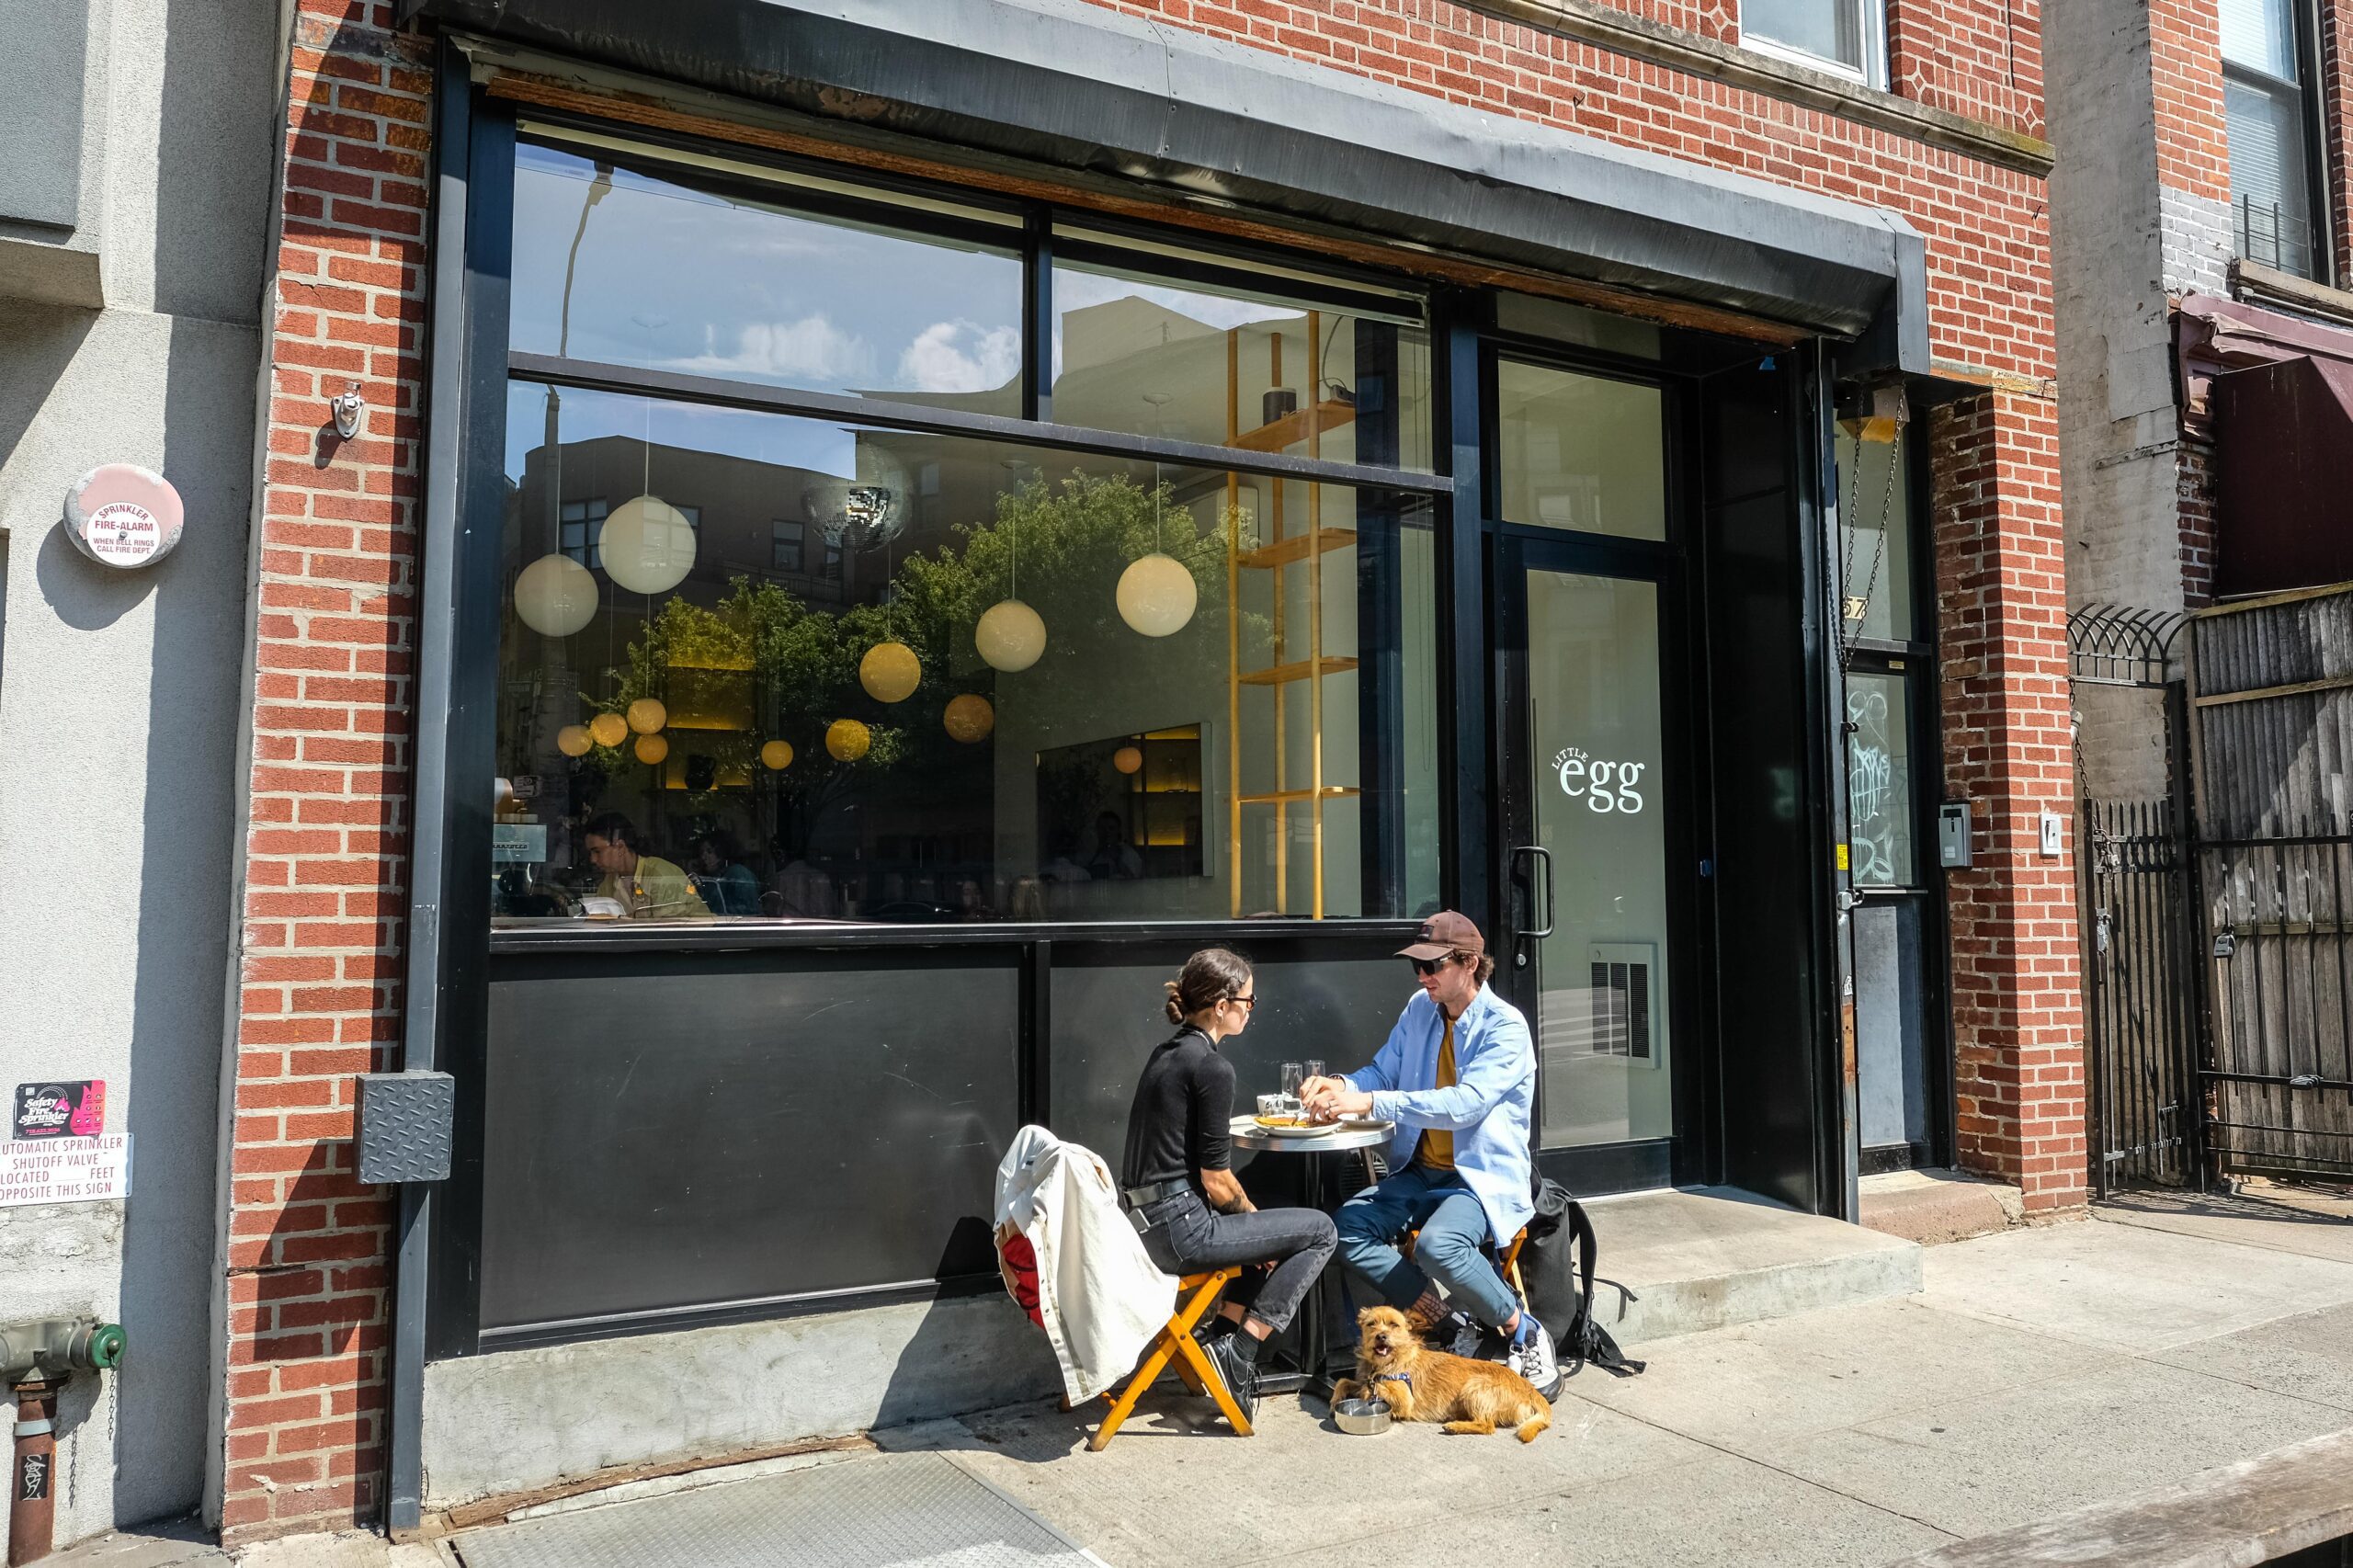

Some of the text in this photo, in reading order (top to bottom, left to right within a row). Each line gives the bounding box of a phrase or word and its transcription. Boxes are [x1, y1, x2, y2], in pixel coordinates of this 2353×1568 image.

[98, 504, 149, 521] SPRINKLER
[95, 520, 153, 531] FIRE-ALARM
[116, 538, 131, 546] BELL
[133, 539, 154, 547] RINGS
[1551, 747, 1589, 770] LITTLE
[1559, 759, 1645, 814] egg
[24, 1096, 58, 1108] Safety
[18, 1110, 70, 1126] Sprinkler
[28, 1107, 51, 1116] Fire
[0, 1137, 123, 1155] UTOMATIC SPRINKLER
[13, 1153, 99, 1170] SHUTOFF VALVE
[0, 1166, 115, 1185] LOCATED FEET
[56, 1184, 81, 1197] THIS
[85, 1182, 112, 1194] SIGN
